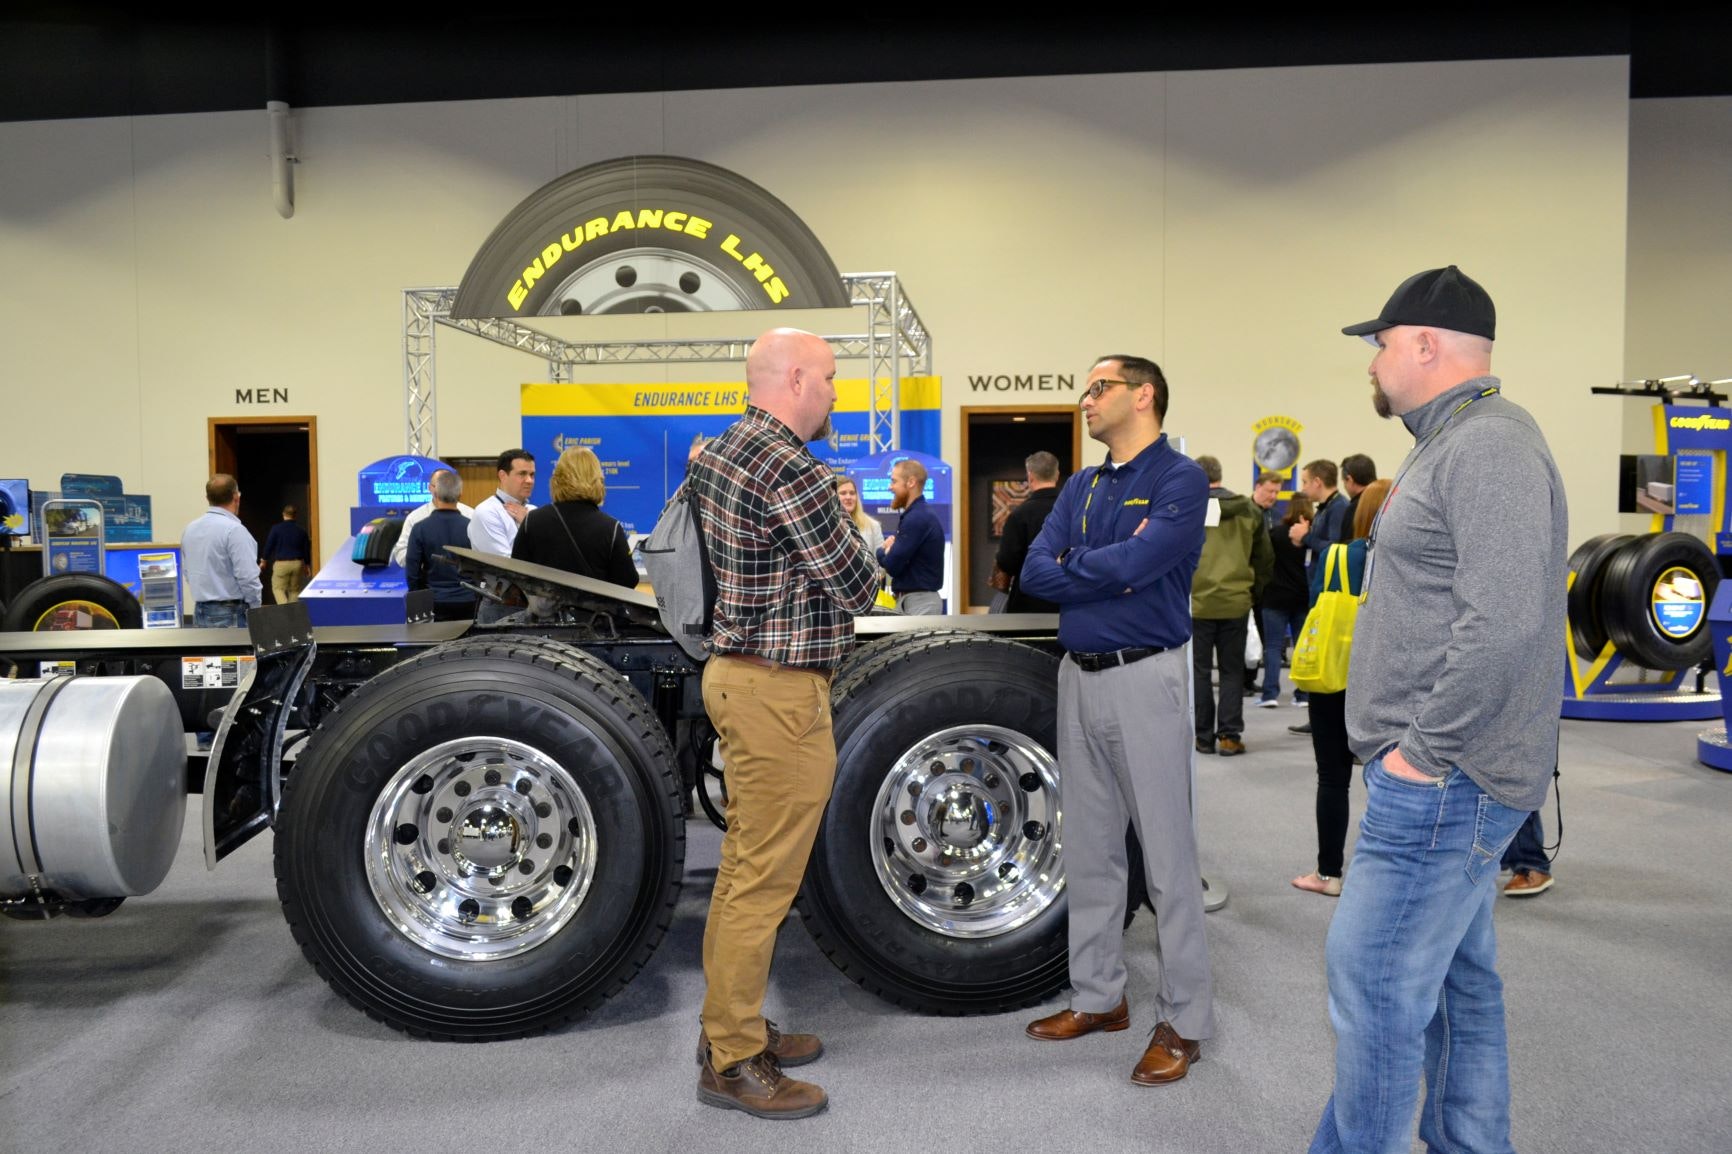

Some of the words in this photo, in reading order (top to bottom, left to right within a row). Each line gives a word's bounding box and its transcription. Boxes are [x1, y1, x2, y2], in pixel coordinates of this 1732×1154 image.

[507, 209, 713, 311] ENDURANCE
[720, 234, 790, 304] LHS
[968, 374, 1075, 391] WOMEN
[235, 388, 289, 404] MEN
[633, 391, 711, 407] ENDURANCE
[714, 391, 739, 406] LHS
[741, 390, 751, 405] H
[1669, 414, 1731, 431] GOODYEAR
[344, 694, 624, 799] GOODYEAR
